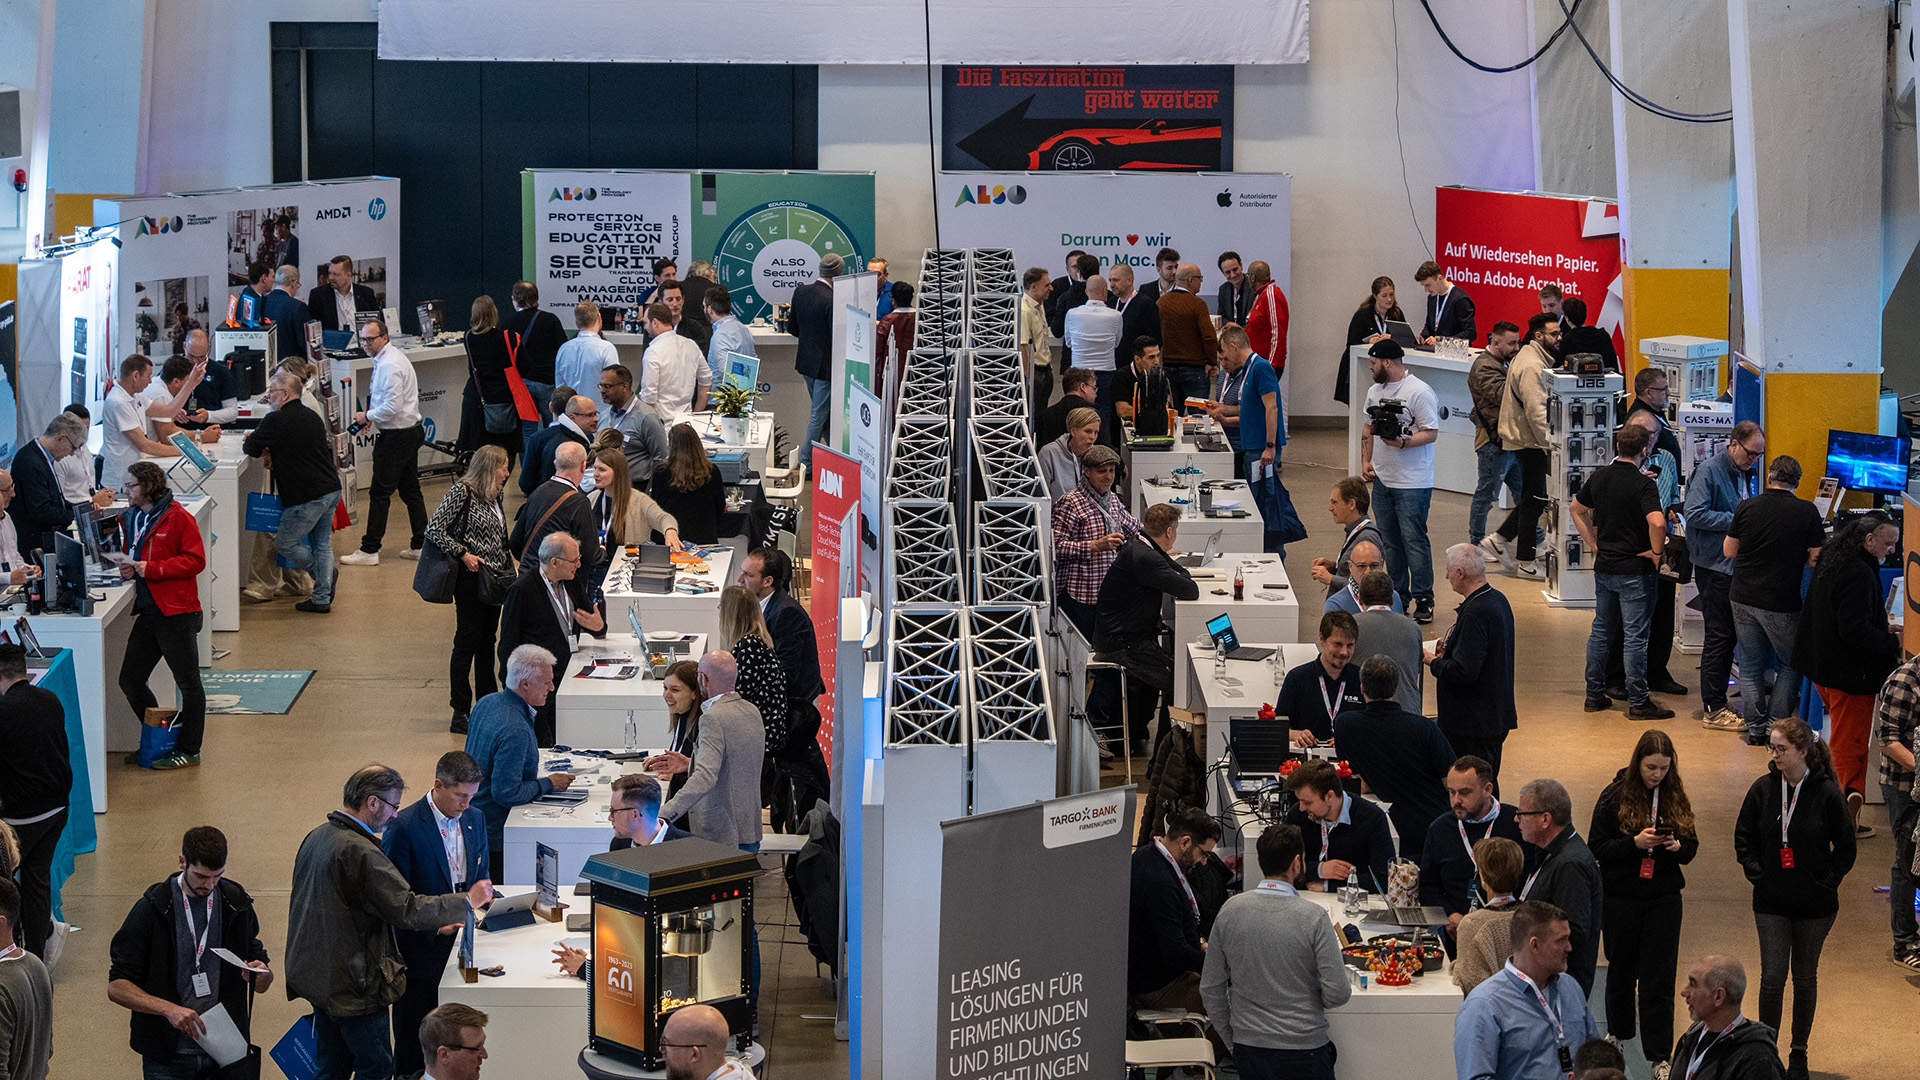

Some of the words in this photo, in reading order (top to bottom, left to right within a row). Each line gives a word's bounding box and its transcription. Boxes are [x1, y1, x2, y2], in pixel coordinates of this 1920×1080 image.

[956, 68, 992, 87] Die
[999, 68, 1126, 87] Faszination
[1085, 90, 1135, 114] geht
[1141, 90, 1220, 109] weiter
[548, 187, 598, 203] ALSO
[954, 184, 1027, 208] ALSO
[1239, 192, 1278, 200] Autorisierter
[369, 197, 387, 221] hp
[1239, 200, 1273, 208] Distributor
[316, 207, 345, 220] AMD
[549, 213, 643, 222] PROTECTION
[134, 215, 184, 240] ALSO
[594, 223, 663, 232] SERVICE
[549, 233, 661, 244] EDUCATION
[1061, 233, 1120, 246] Darum
[1145, 232, 1172, 246] wir
[583, 245, 655, 255] SYSTEM
[771, 258, 806, 266] ALSO
[1114, 254, 1155, 267] Mac.
[1444, 242, 1467, 258] Auf
[1469, 245, 1553, 267] Wiedersehen
[1556, 253, 1600, 273] Papier.
[549, 270, 581, 279] MSP
[619, 276, 656, 285] CLOU
[763, 269, 813, 280] Security
[1445, 266, 1481, 284] Aloha
[1483, 271, 1525, 289] Adobe
[1527, 275, 1582, 296] Acrbat.
[566, 285, 650, 294] MANAGEME
[772, 280, 804, 288] Circle
[578, 294, 640, 303] MANAG
[1576, 379, 1605, 388] UAG
[418, 389, 446, 397] CHNOLOGY
[819, 468, 844, 499] ADN
[1050, 812, 1083, 827] TARGO
[1092, 804, 1118, 819] BANK
[1079, 818, 1117, 831] FIRMENKUNDEN
[951, 958, 1021, 995] LEASING
[951, 980, 1044, 1022] LÖSUNGEN
[1049, 972, 1083, 999] FÜR
[950, 998, 1088, 1050] FIRMENKUNDEN
[950, 1049, 989, 1077] UND
[993, 1026, 1082, 1067] BILDUNGS
[976, 1051, 1089, 1080] CHTUNGEN
